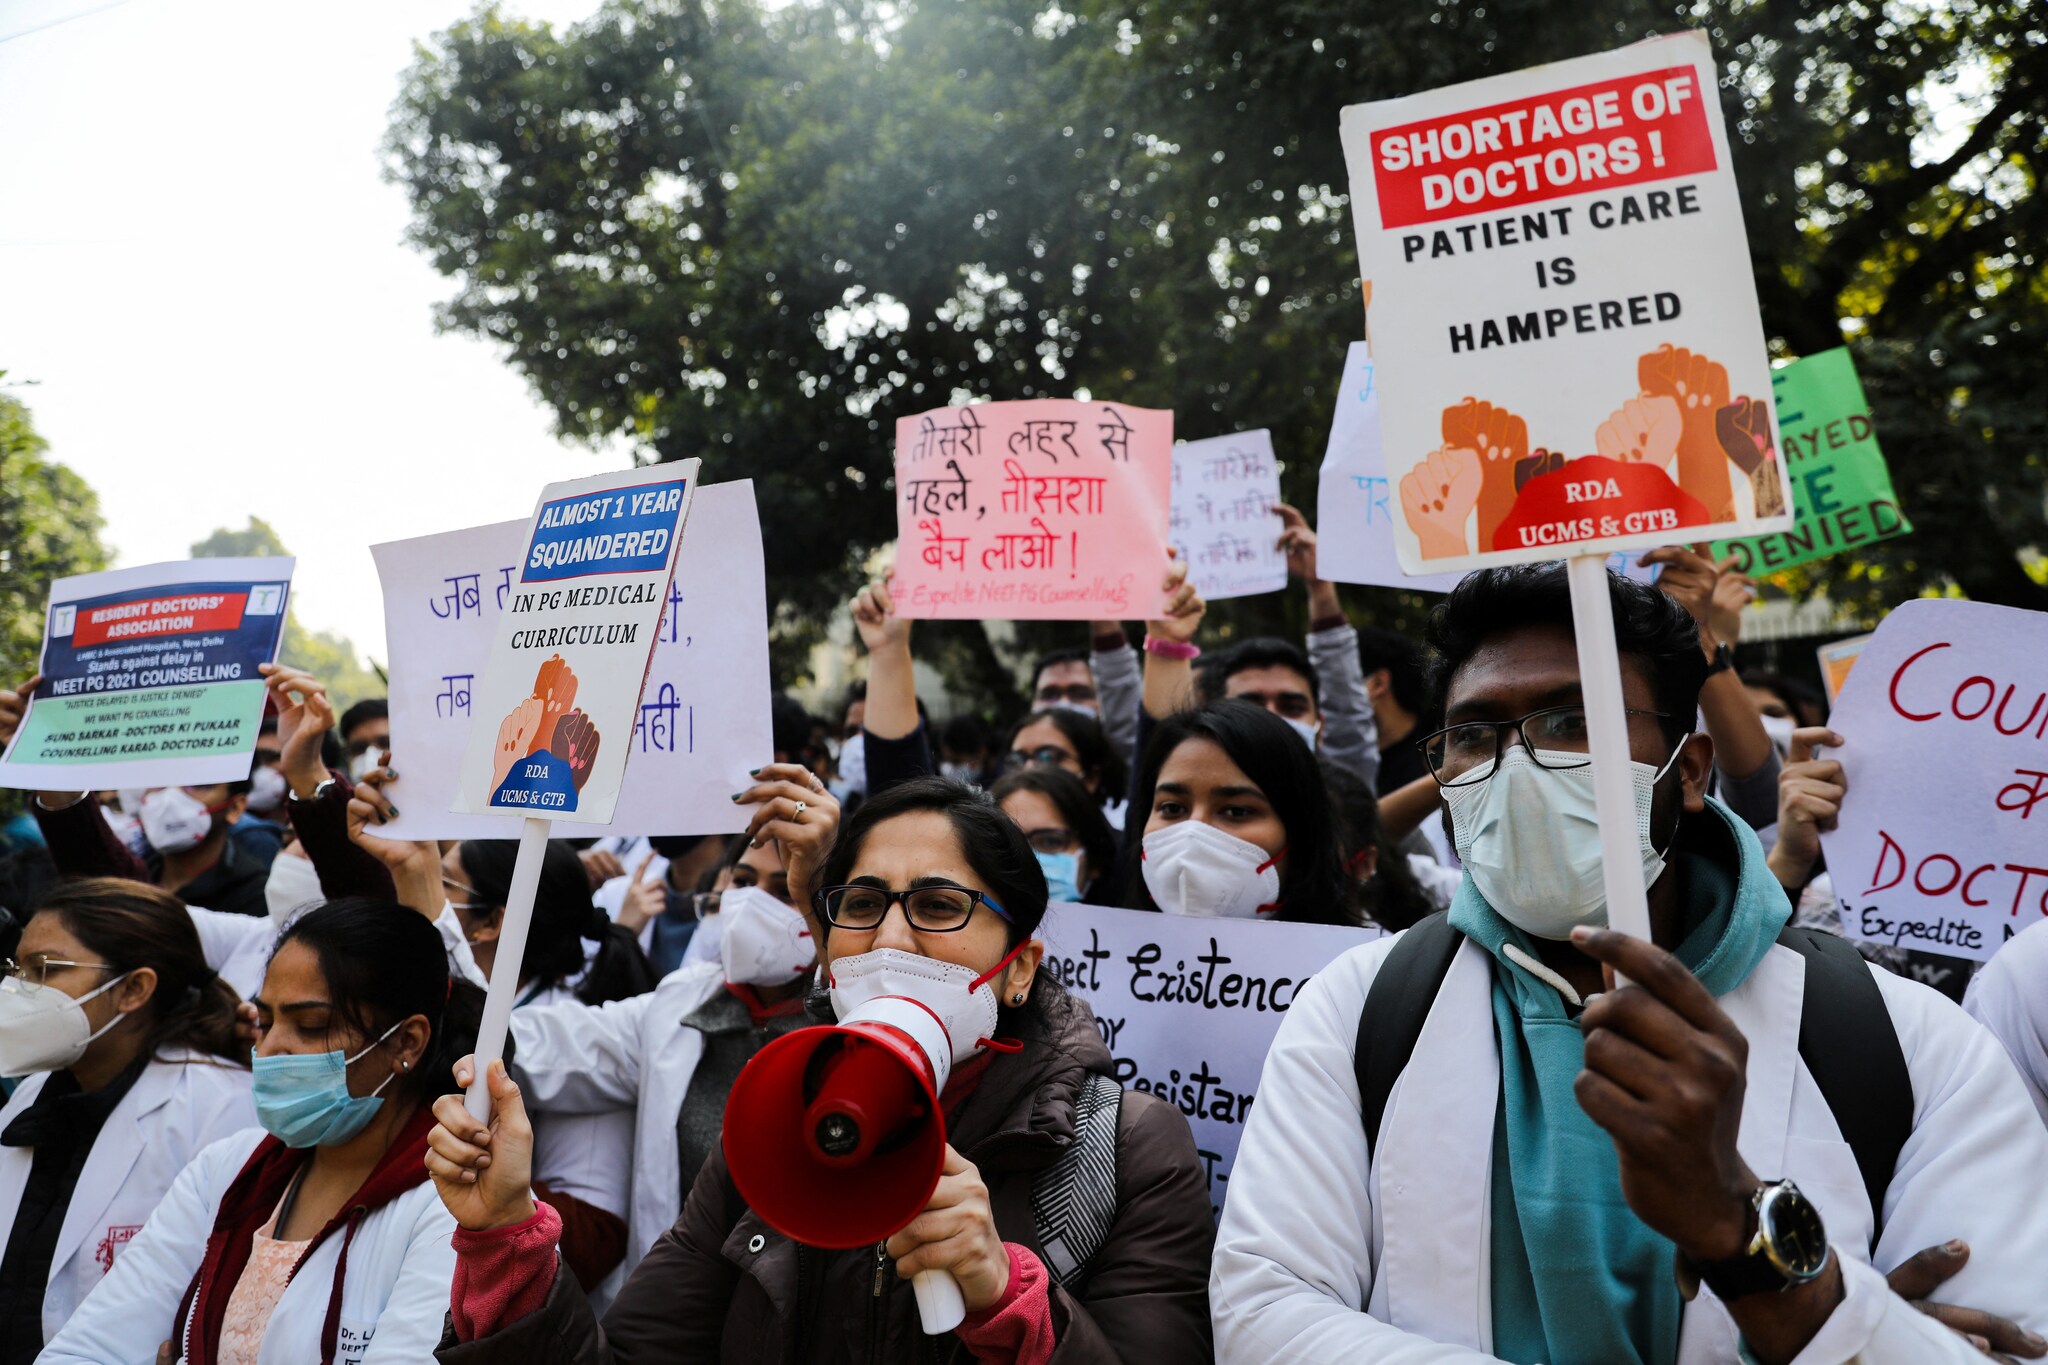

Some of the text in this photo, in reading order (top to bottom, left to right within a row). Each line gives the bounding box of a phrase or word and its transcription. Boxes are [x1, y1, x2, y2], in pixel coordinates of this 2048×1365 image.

[1378, 76, 1693, 172] SHORTAGE OF
[1402, 184, 1701, 263] PATIENT CARE
[1535, 255, 1577, 289] IS
[1449, 291, 1682, 353] HAMPERED
[911, 406, 1135, 464] तीसरी लहर से
[1783, 414, 1872, 464] AYED
[1001, 458, 1107, 515] तीसरा
[1564, 477, 1623, 504] RDA
[538, 488, 682, 530] ALMOST 1 YEAR
[1518, 507, 1679, 547] UCMS & GTB
[1727, 498, 1905, 574] DENIED
[529, 528, 669, 570] SQUANDERED
[918, 518, 970, 572] बैच
[91, 602, 148, 624] RESIDENT
[430, 573, 481, 620] जब
[512, 583, 657, 613] IN PG MEDICAL
[107, 615, 194, 638] ASSOCIATION
[182, 638, 201, 648] New
[202, 636, 225, 647] Delhi
[511, 623, 639, 650] CURRICULUM
[87, 649, 204, 674] Stands against delay in
[52, 663, 241, 695] NEET PG 2021 COUNSELLING
[436, 674, 474, 718] तब
[84, 706, 191, 724] WE WANT PG COUNSELLING
[96, 696, 129, 707] DELAYED
[130, 696, 137, 704] IS
[140, 691, 169, 703] JUSTICE
[39, 744, 118, 758] COUNSELLING
[160, 738, 214, 751] DOCTORS
[217, 736, 240, 747] LAO
[44, 732, 76, 743] SUNO
[77, 726, 119, 741] SARKAR
[178, 723, 191, 732] KI
[193, 718, 241, 731] PUKAAR
[524, 764, 549, 779] RDA
[500, 789, 566, 806] UCMS & GTB
[1861, 830, 2048, 917] DOCT
[1048, 928, 1311, 1013] pect Existenc
[341, 1327, 357, 1340] Dr.
